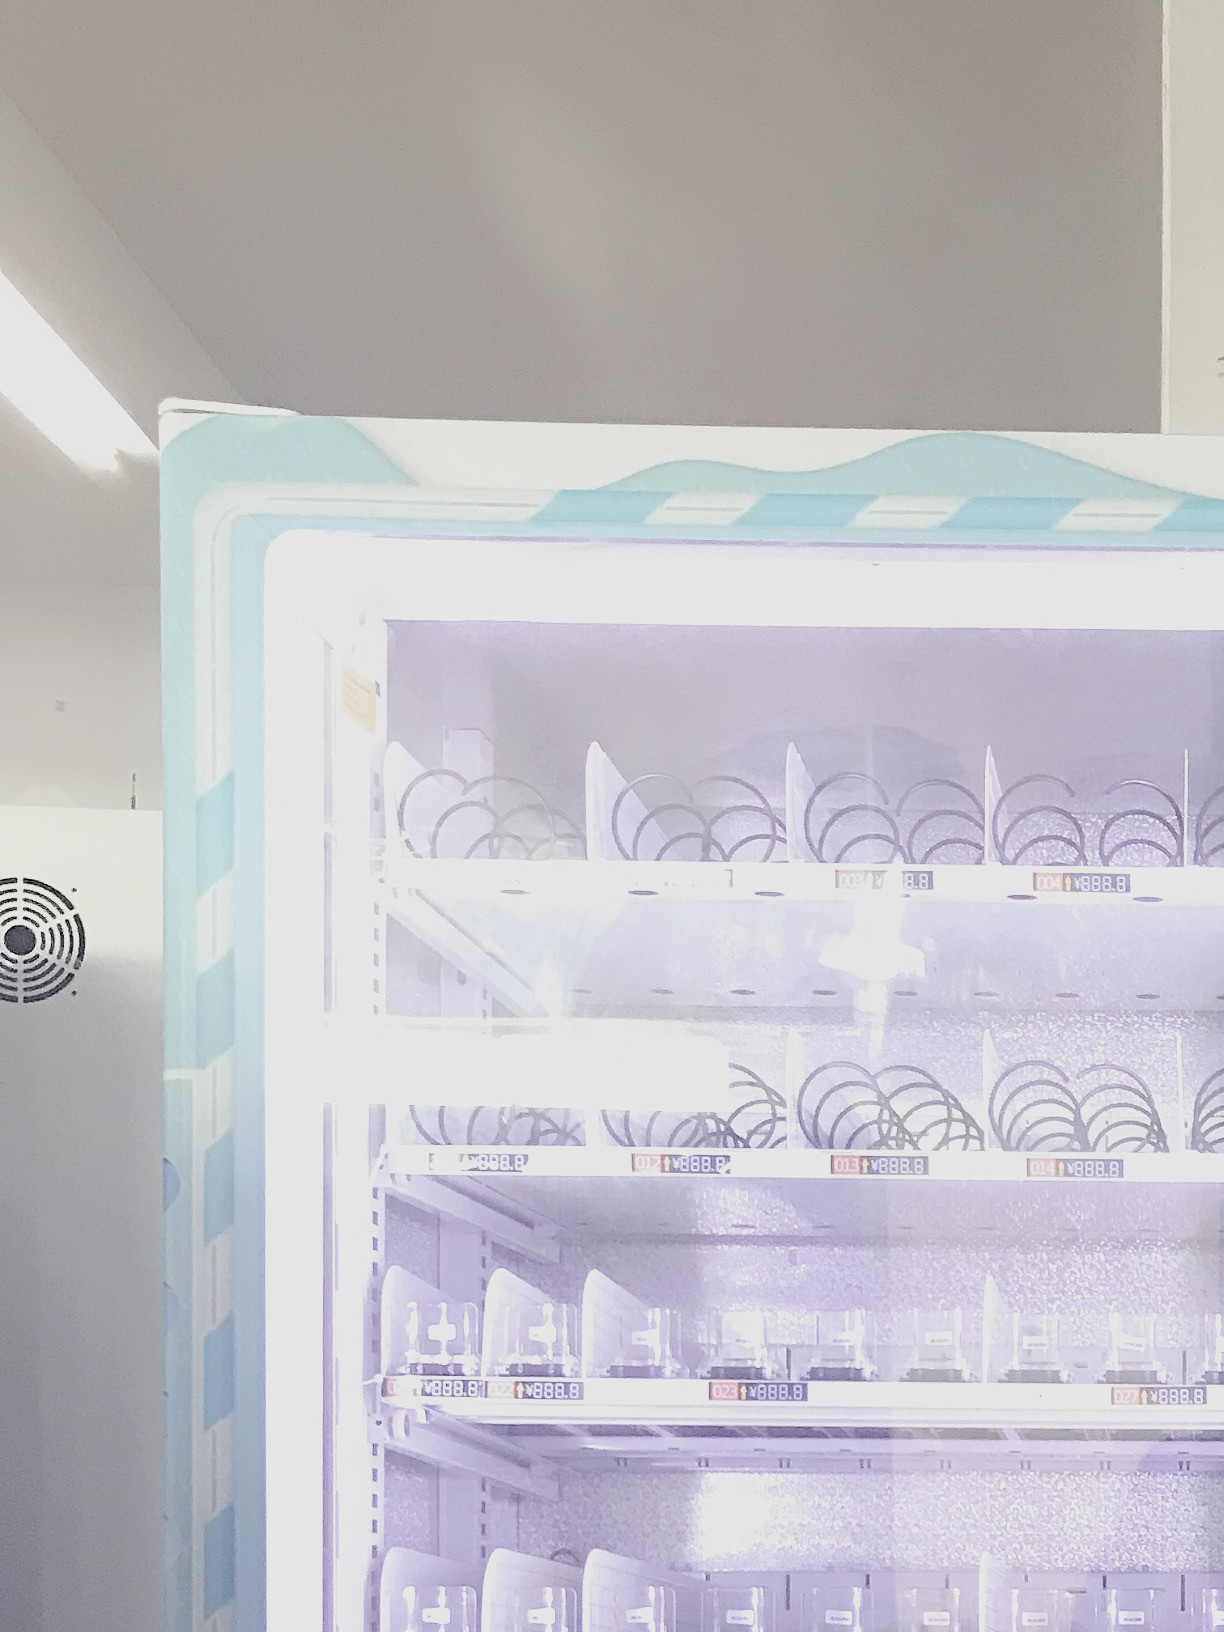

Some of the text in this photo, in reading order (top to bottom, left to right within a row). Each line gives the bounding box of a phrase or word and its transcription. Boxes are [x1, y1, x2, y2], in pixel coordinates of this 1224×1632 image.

[1035, 876, 1062, 891] 004
[834, 1157, 858, 1173] 013
[1030, 1160, 1055, 1176] 014
[712, 1383, 737, 1398] 023
[1113, 1389, 1139, 1403] 027
